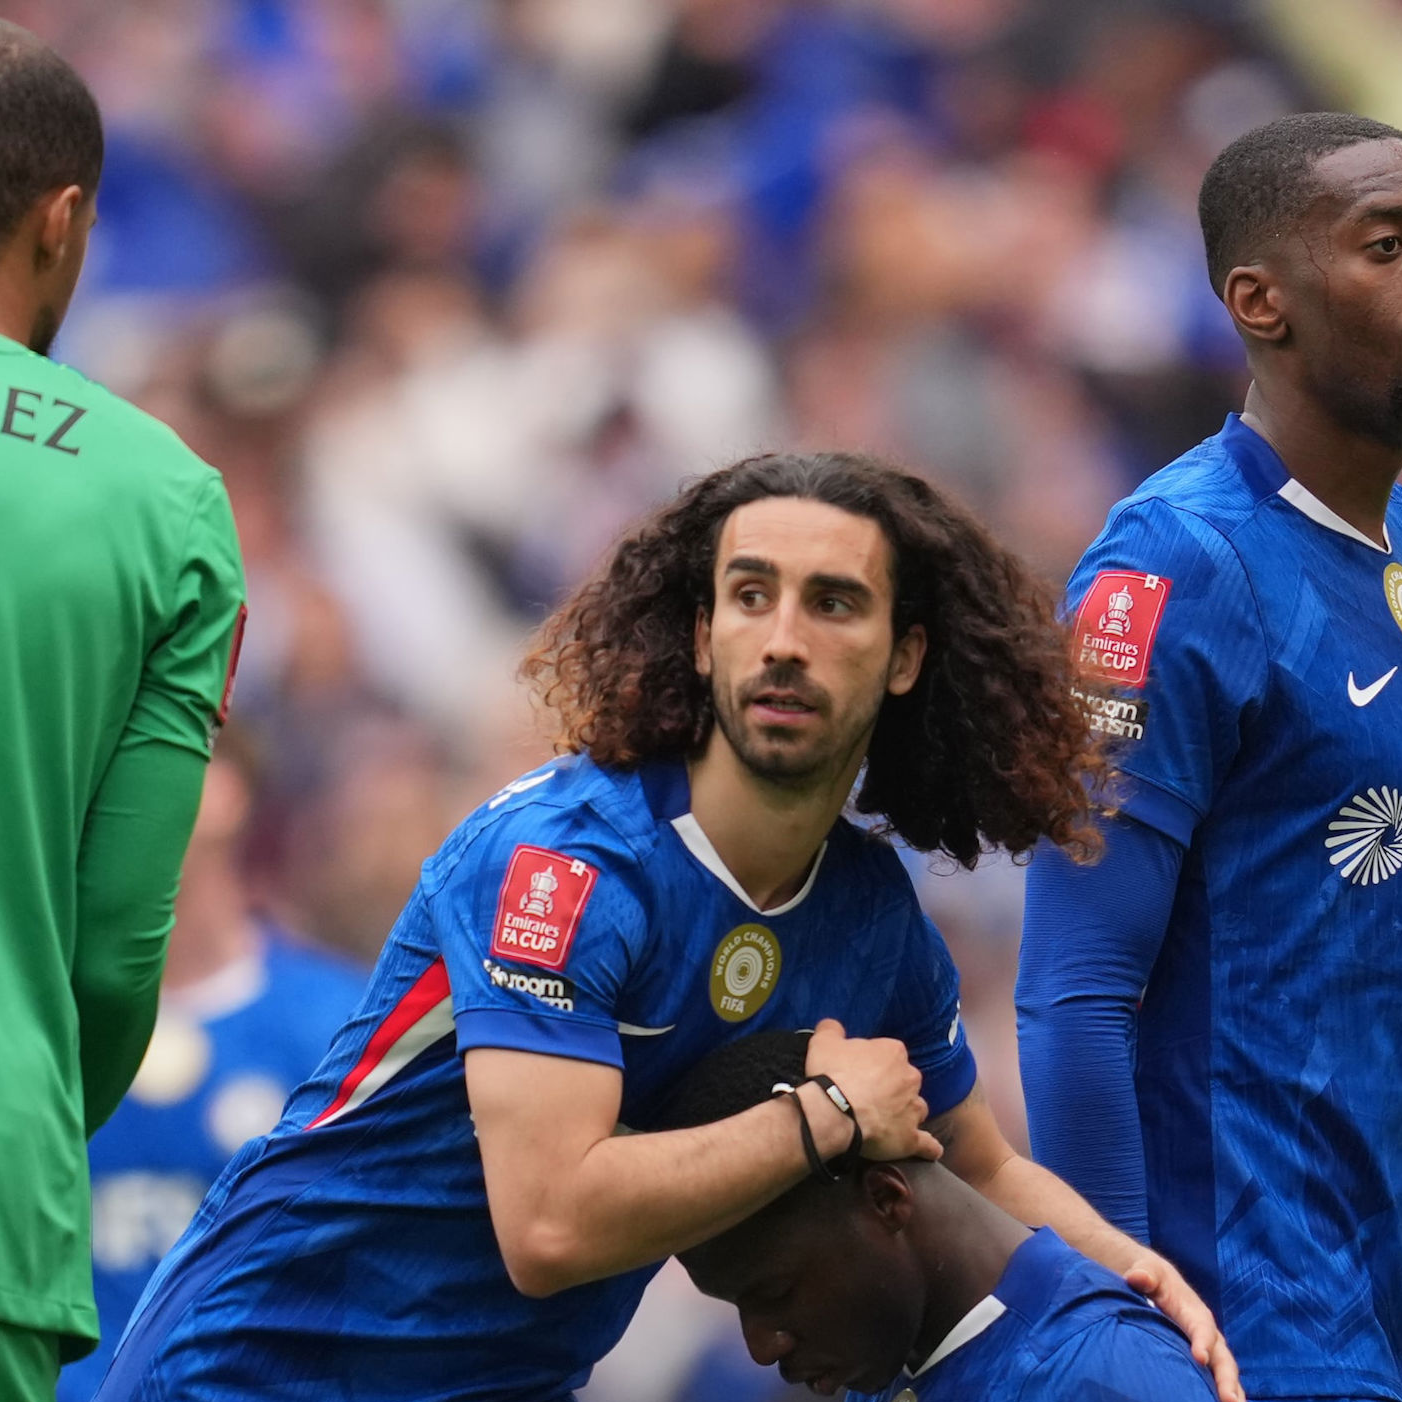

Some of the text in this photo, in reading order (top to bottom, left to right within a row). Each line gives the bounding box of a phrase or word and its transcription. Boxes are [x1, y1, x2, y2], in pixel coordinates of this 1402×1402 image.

[1083, 633, 1139, 656] Emirates
[1079, 648, 1137, 671] FA CUP
[504, 912, 560, 938] Emirates
[501, 928, 557, 952] FA CUP
[715, 932, 775, 989] WORLD CHAMPIONS
[720, 996, 745, 1013] FIFA
